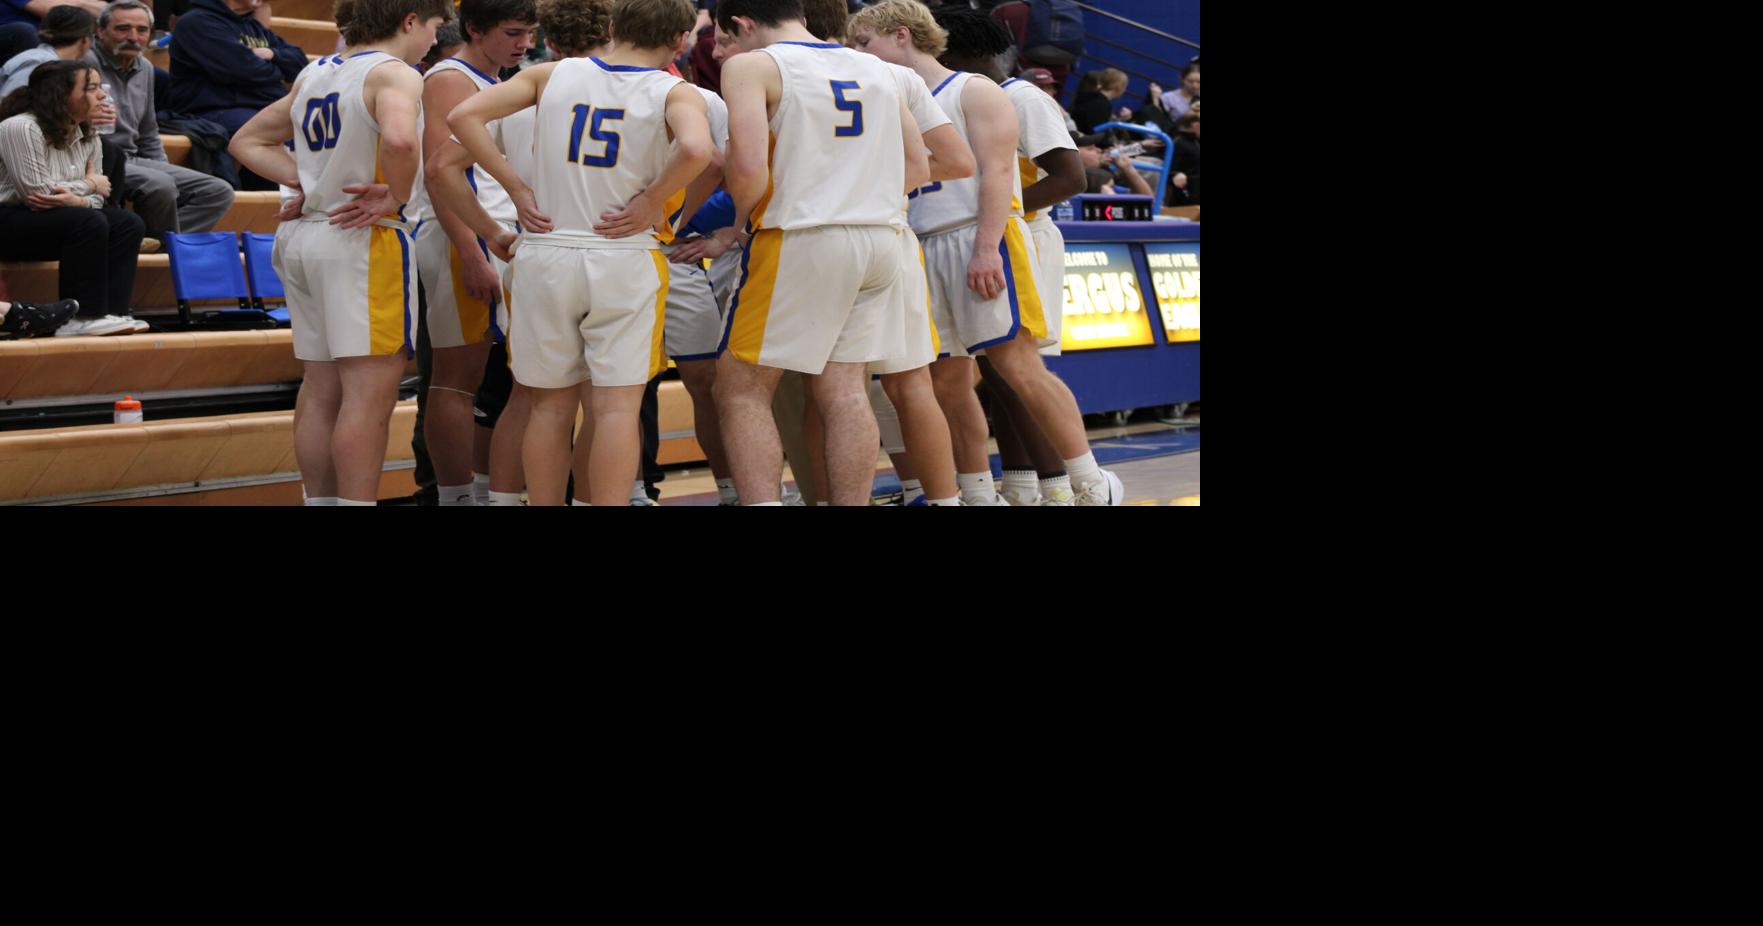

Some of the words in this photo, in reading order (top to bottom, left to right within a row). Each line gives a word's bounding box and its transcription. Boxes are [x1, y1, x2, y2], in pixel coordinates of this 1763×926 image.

[302, 91, 342, 153] 00
[566, 103, 625, 169] 15
[829, 79, 864, 138] 5
[1063, 251, 1098, 267] ELCOME
[1061, 272, 1141, 315] ERGUS
